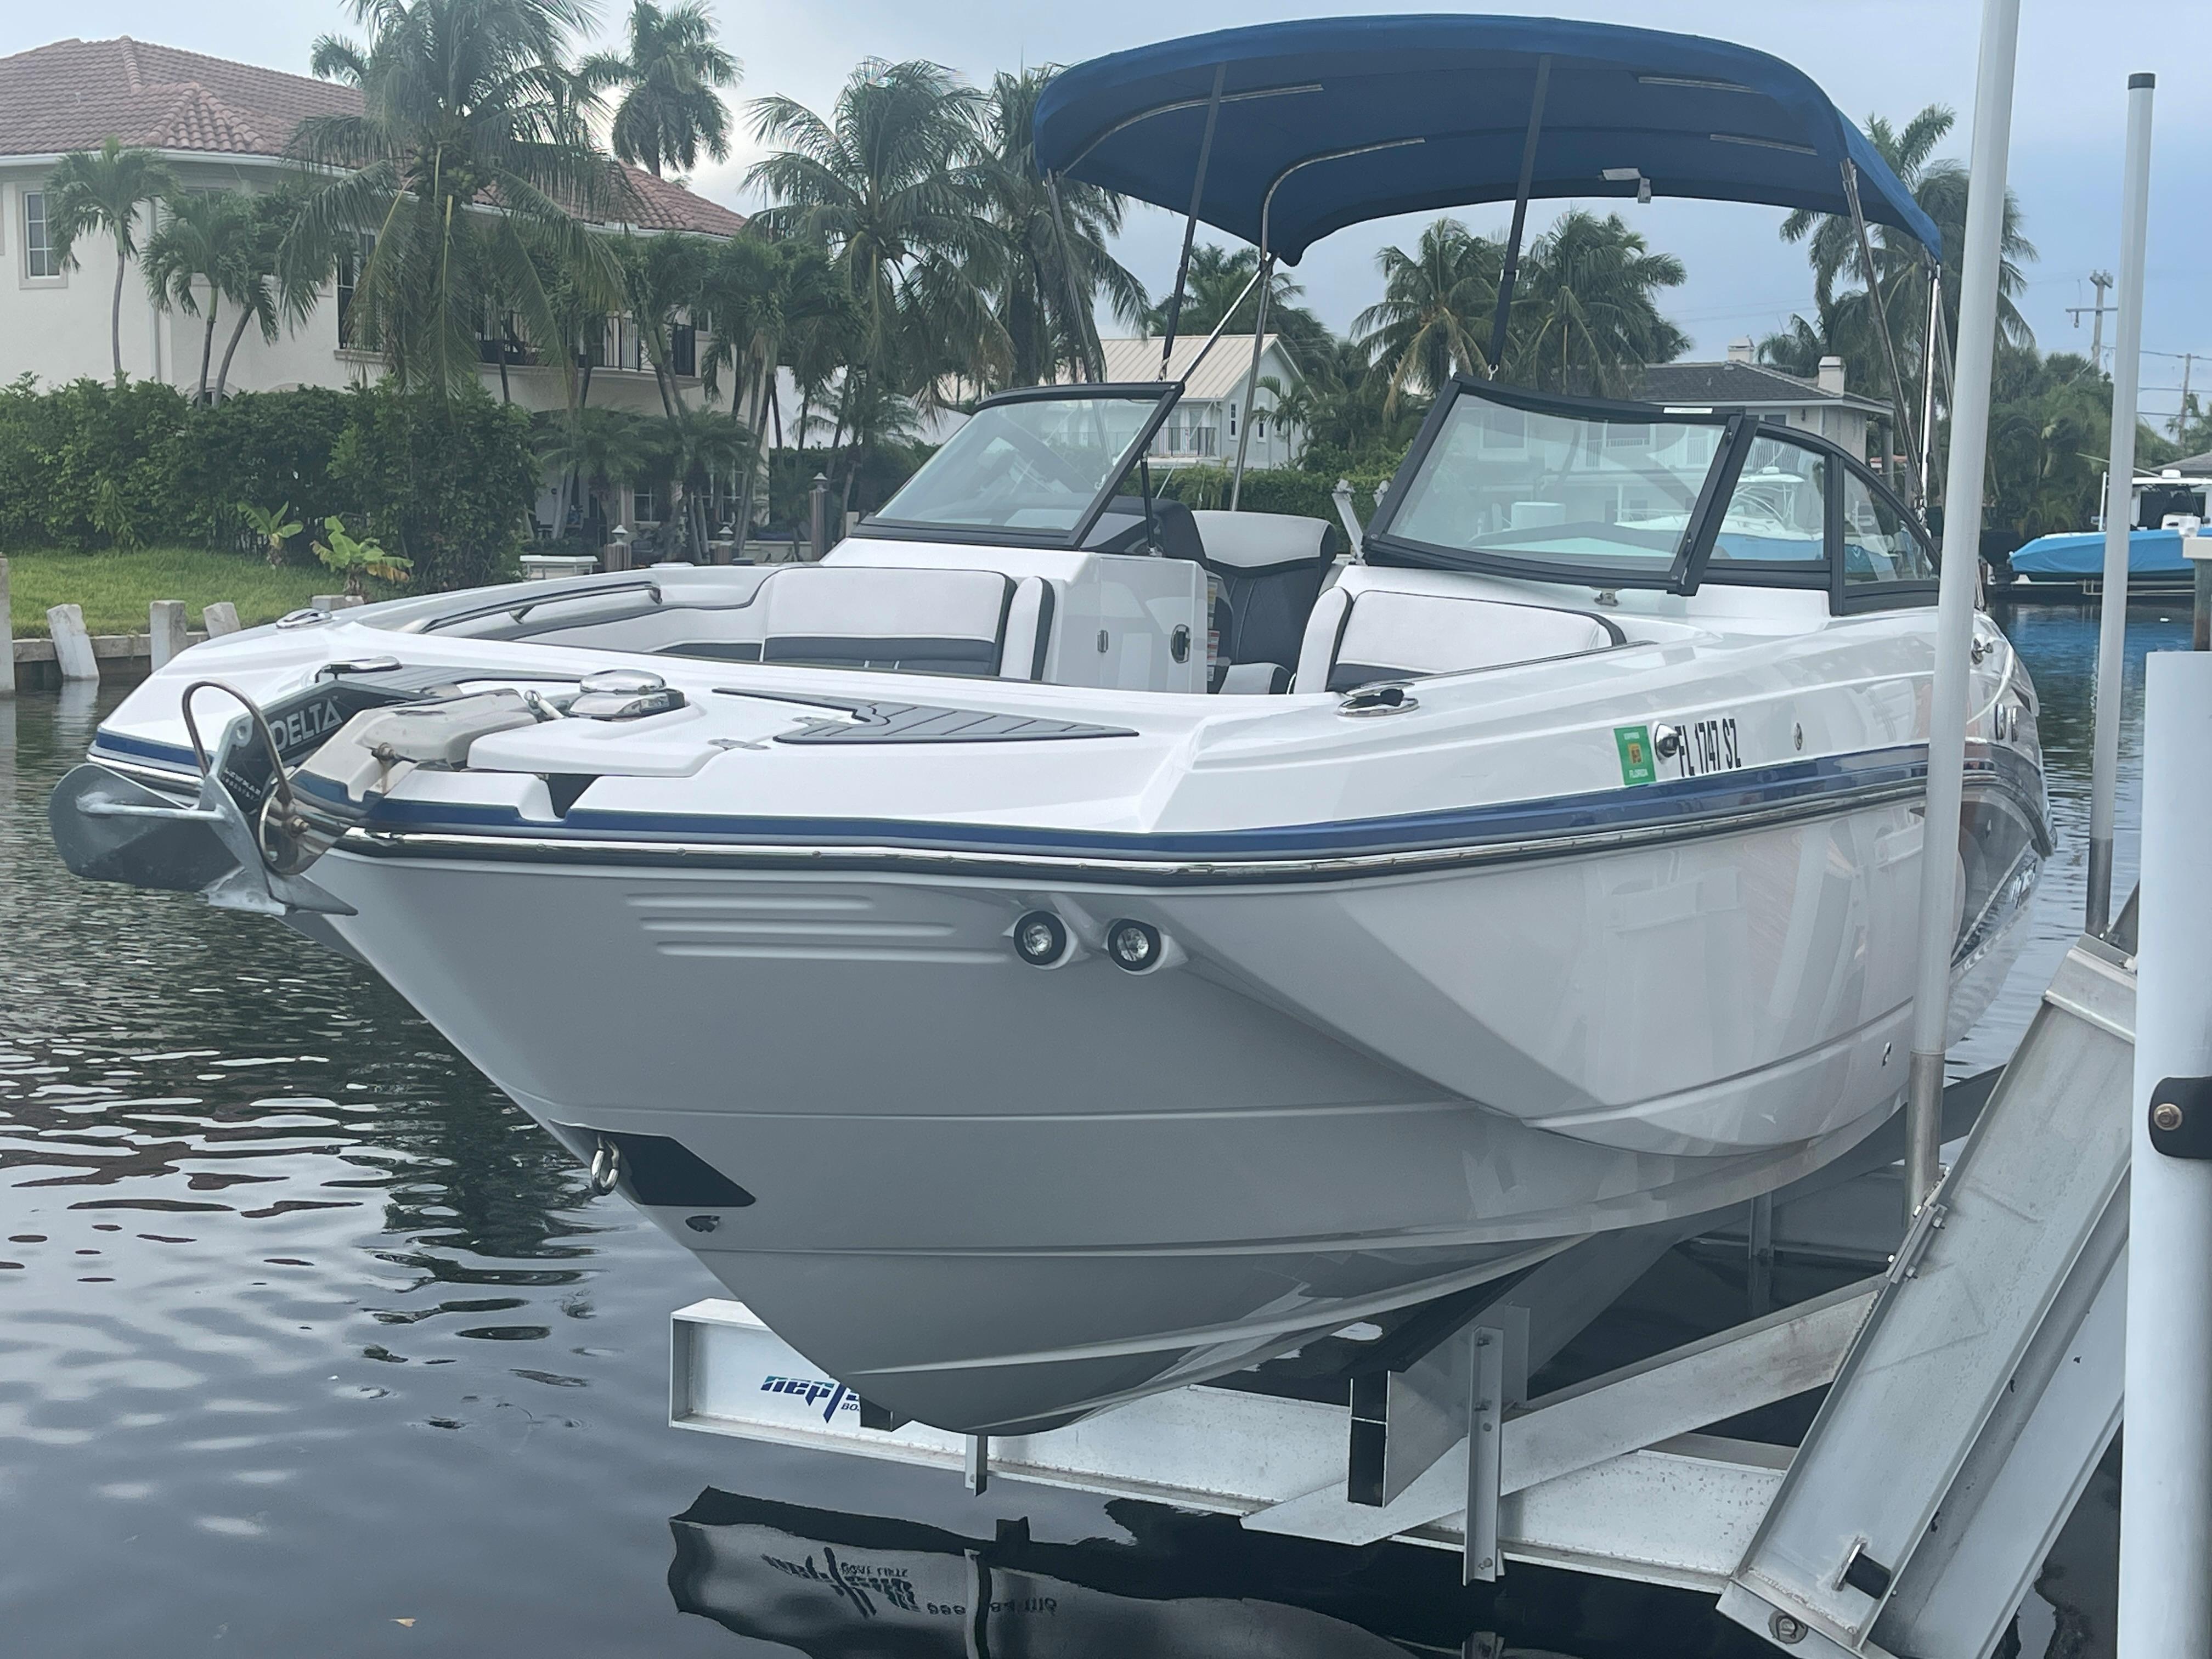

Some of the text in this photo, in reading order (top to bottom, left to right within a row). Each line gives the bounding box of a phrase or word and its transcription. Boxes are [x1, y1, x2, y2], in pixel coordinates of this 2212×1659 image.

[269, 698, 343, 751] DELTA
[1675, 718, 1741, 777] FL 1747 SZ
[760, 1375, 859, 1424] nept
[840, 1402, 860, 1411] BO
